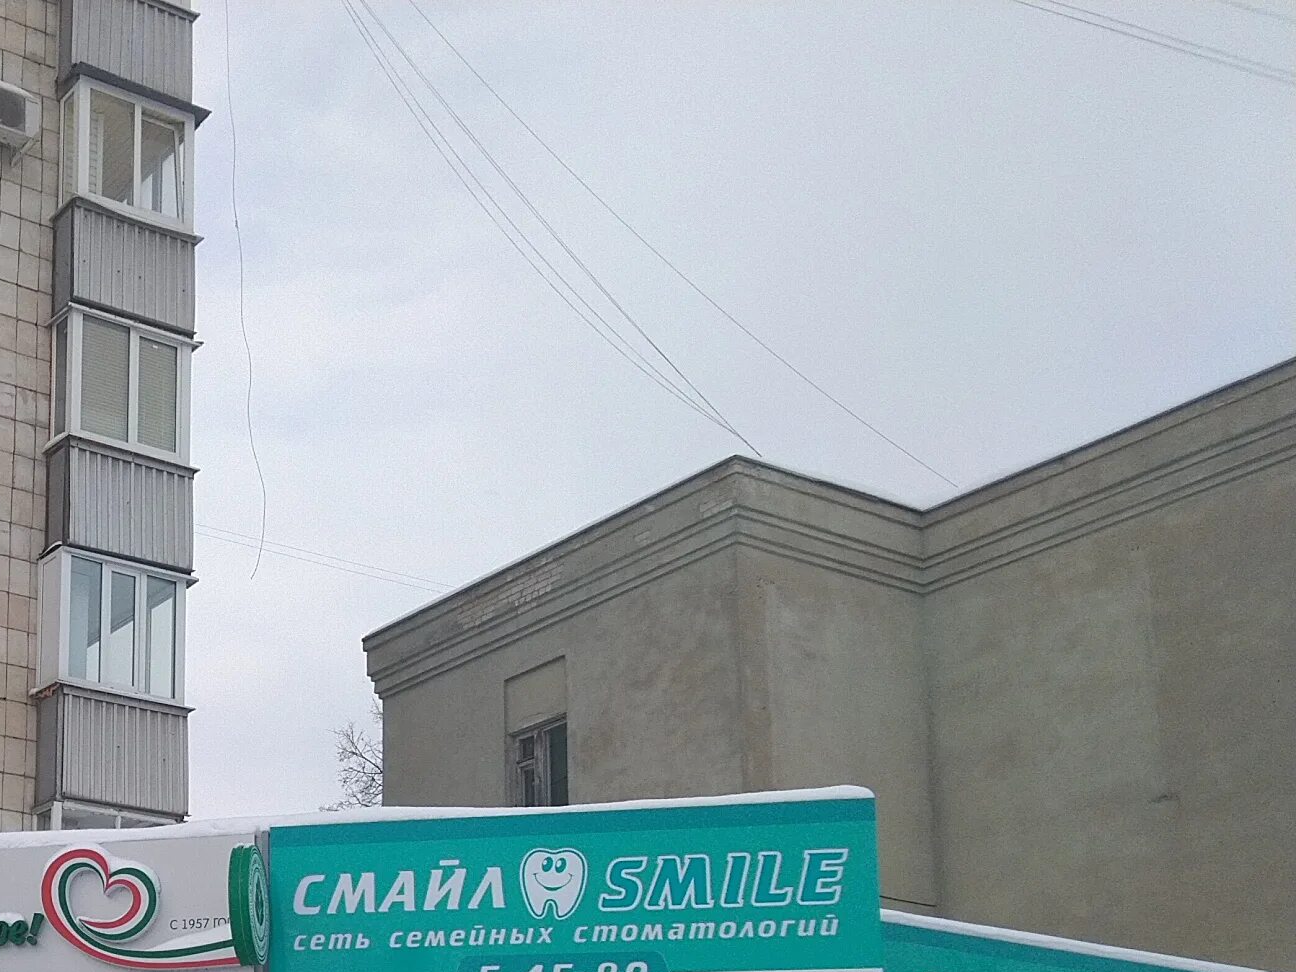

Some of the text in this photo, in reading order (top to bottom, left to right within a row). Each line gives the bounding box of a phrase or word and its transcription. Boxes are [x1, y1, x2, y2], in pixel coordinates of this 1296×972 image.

[293, 847, 849, 916] СМАЙЛ SMILE
[182, 917, 210, 930] 1957
[293, 914, 840, 952] сеть семейных стоматологий
